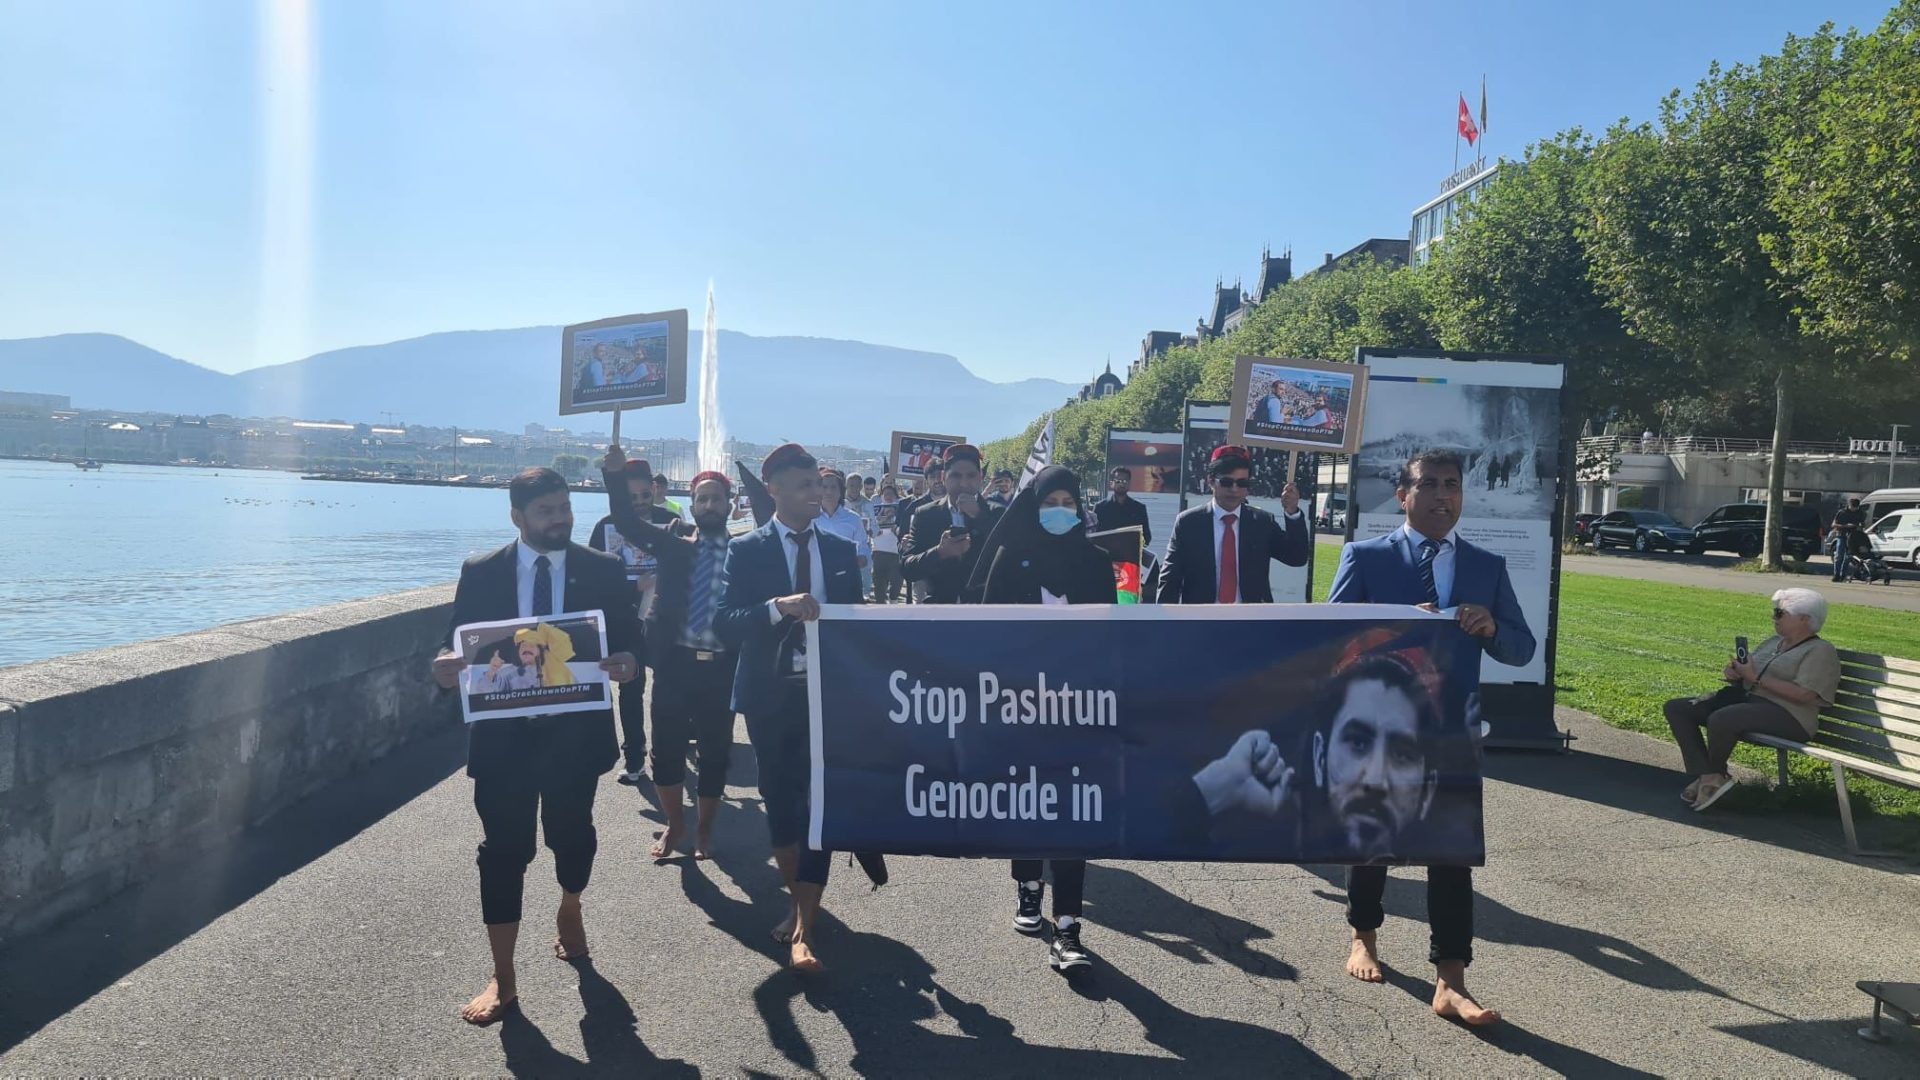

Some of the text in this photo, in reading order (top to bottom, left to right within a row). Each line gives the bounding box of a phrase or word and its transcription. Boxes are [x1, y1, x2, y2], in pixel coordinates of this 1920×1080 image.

[1256, 422, 1334, 435] #StopCrackdownOnPTM
[484, 685, 591, 701] #StopCrackdownOnPTM
[889, 670, 1116, 738] Stop Pashtun
[906, 764, 1101, 821] Genocide in
